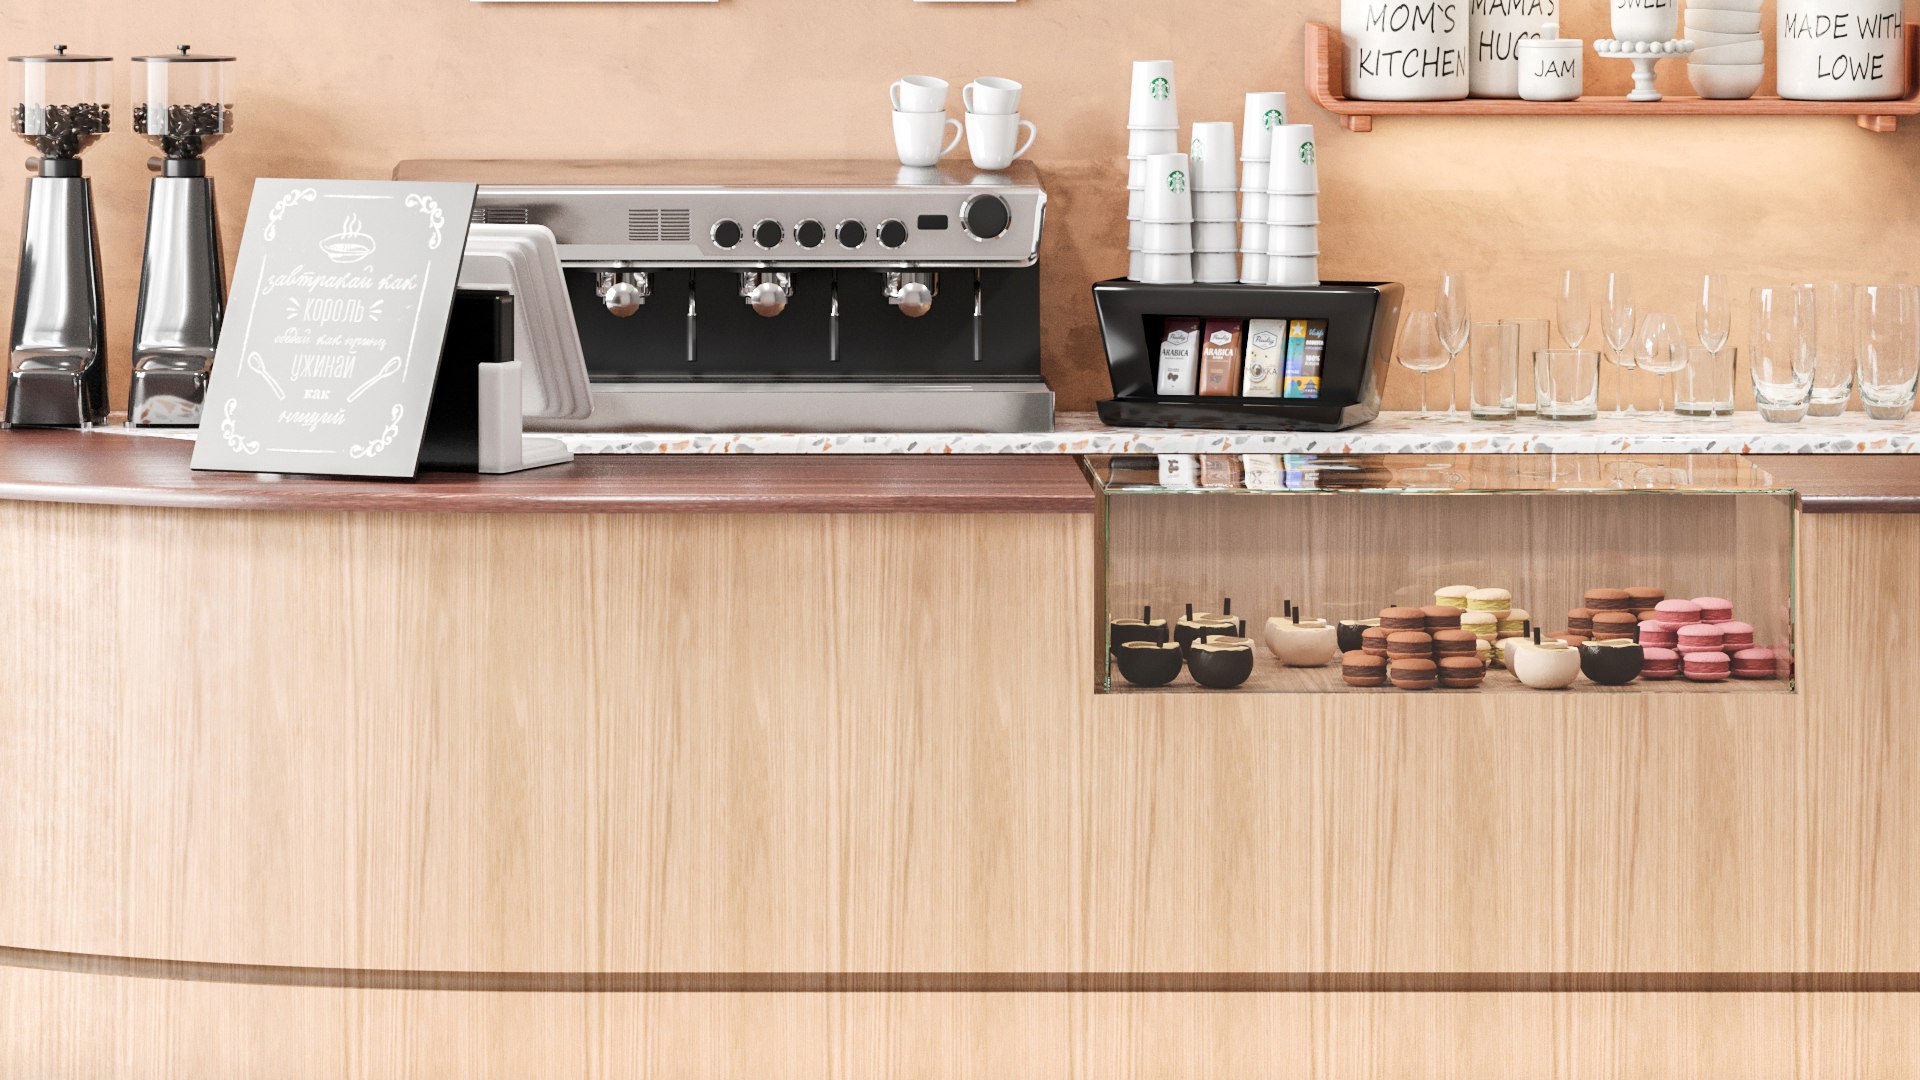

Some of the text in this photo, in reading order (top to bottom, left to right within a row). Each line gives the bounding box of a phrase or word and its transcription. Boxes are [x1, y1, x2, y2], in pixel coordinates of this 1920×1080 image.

[1784, 10, 1902, 39] MADE WITH
[1359, 46, 1466, 78] KITCHEN
[1534, 59, 1576, 78] JAM
[1817, 52, 1884, 81] LOWE
[262, 265, 418, 295] завтракай как
[1162, 348, 1189, 357] ARABICA
[1204, 347, 1234, 357] ARABICA
[304, 389, 331, 400] как
